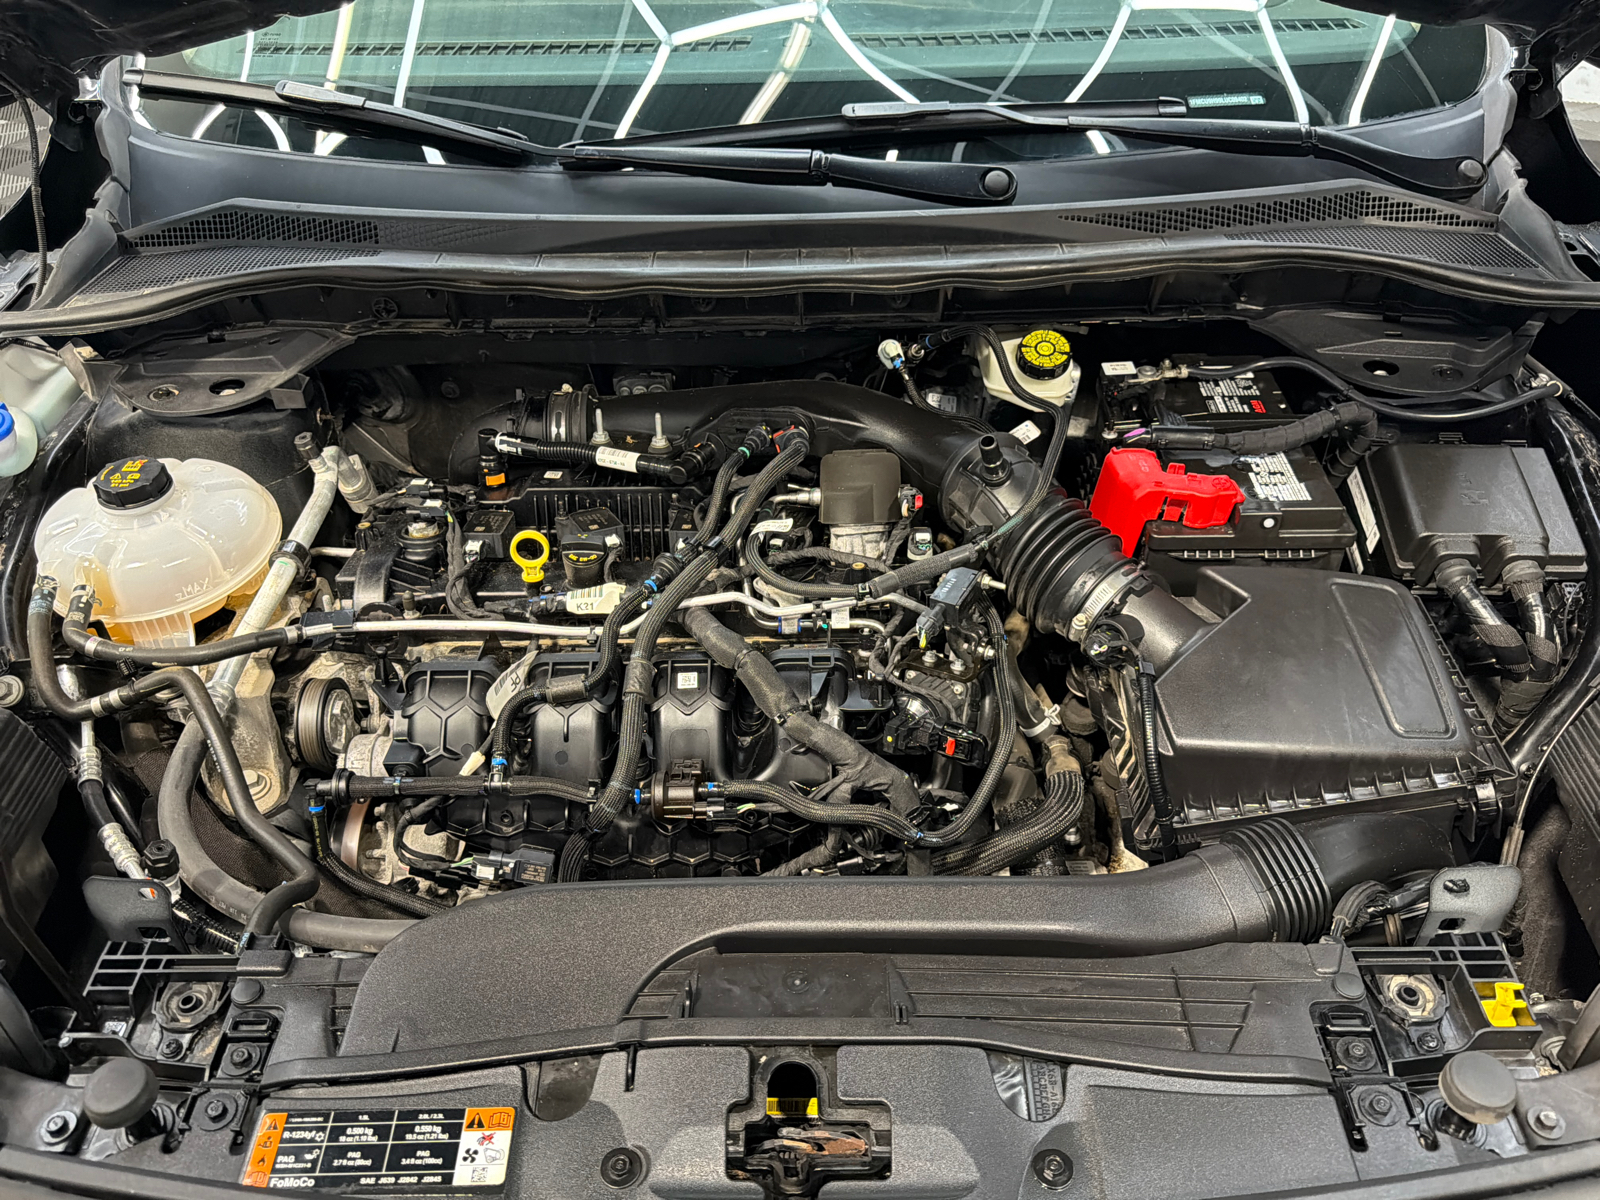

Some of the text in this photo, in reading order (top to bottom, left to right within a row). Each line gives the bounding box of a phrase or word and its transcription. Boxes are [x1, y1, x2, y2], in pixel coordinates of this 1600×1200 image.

[182, 577, 214, 598] MAX
[576, 602, 594, 612] K21
[346, 1126, 374, 1136] 0.500 kg
[414, 1124, 442, 1134] 0.550 kg
[282, 1130, 316, 1140] R-1234yf
[269, 1176, 316, 1188] FoMoCo
[378, 1176, 396, 1184] J639
[397, 1176, 418, 1184] J2842
